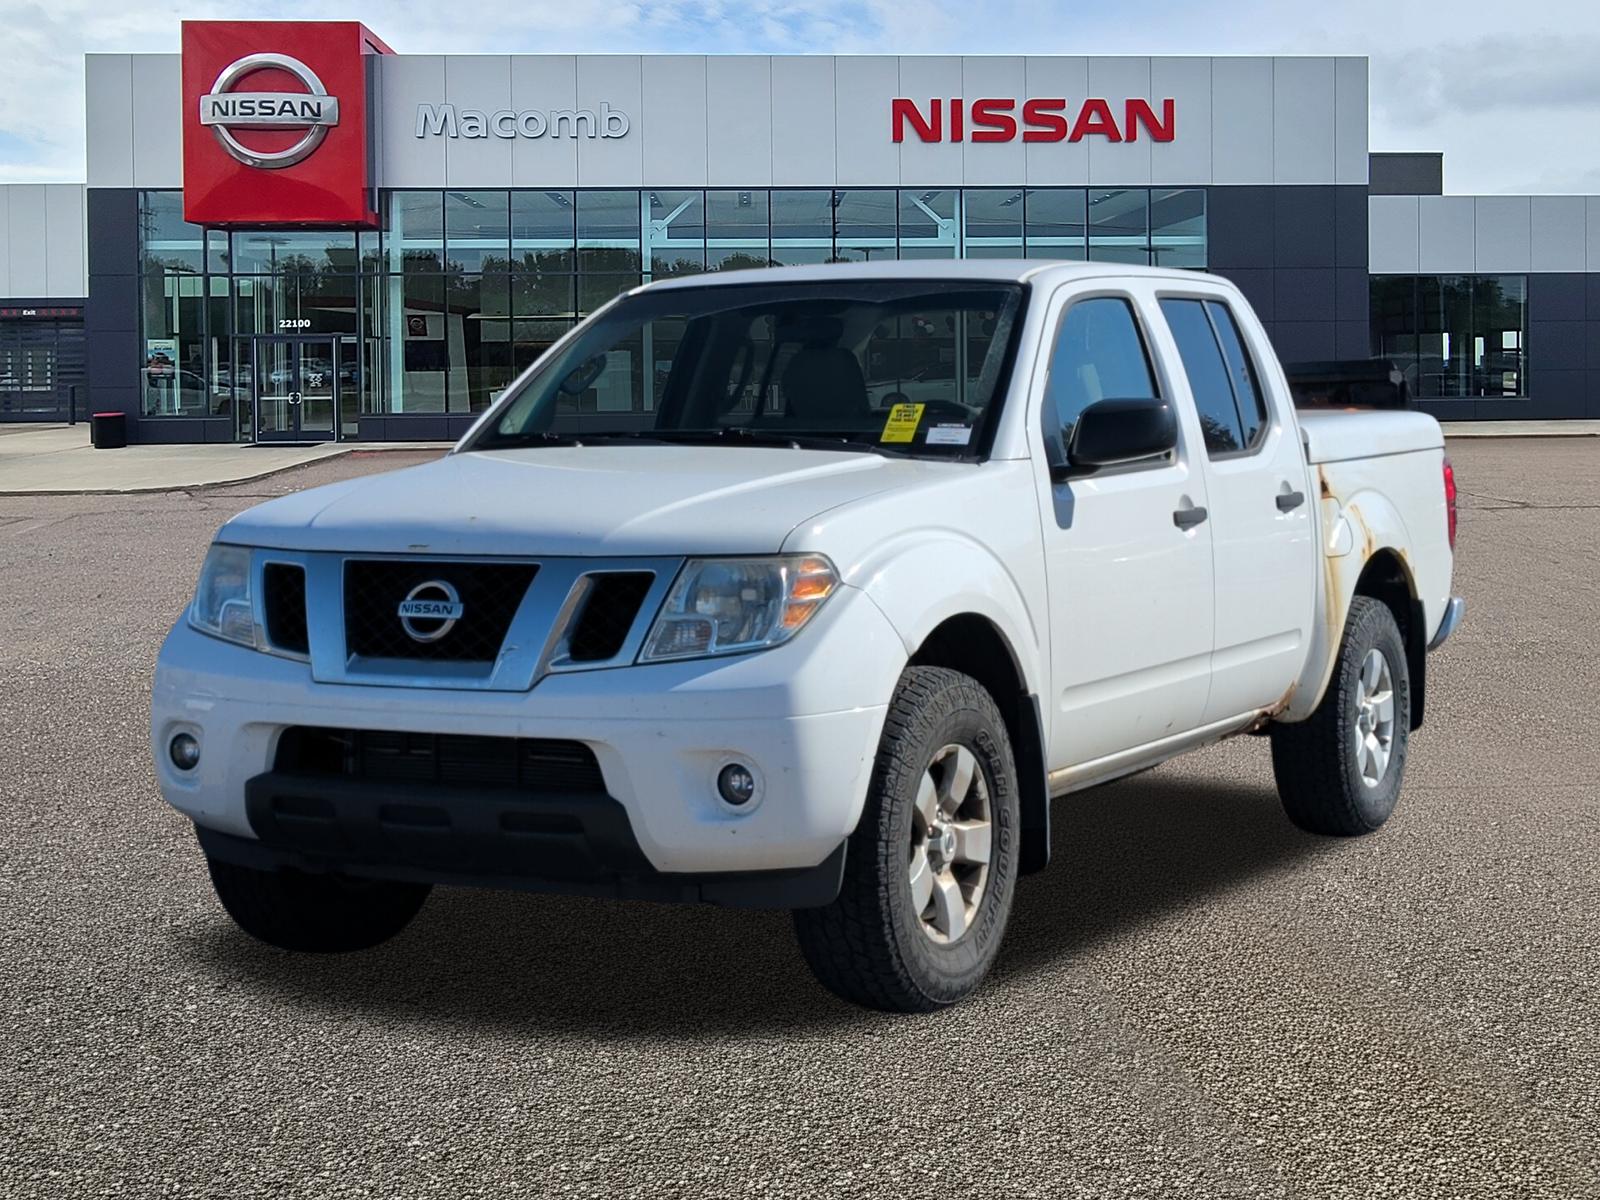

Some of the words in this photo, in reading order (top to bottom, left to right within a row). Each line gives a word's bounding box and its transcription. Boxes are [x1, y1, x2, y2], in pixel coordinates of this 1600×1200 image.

[212, 100, 322, 118] NISSAN
[415, 101, 630, 139] Macomb
[892, 98, 1175, 143] NISSAN
[279, 319, 311, 328] 22100
[401, 603, 454, 615] NISSAN
[976, 729, 1008, 797] OPEN
